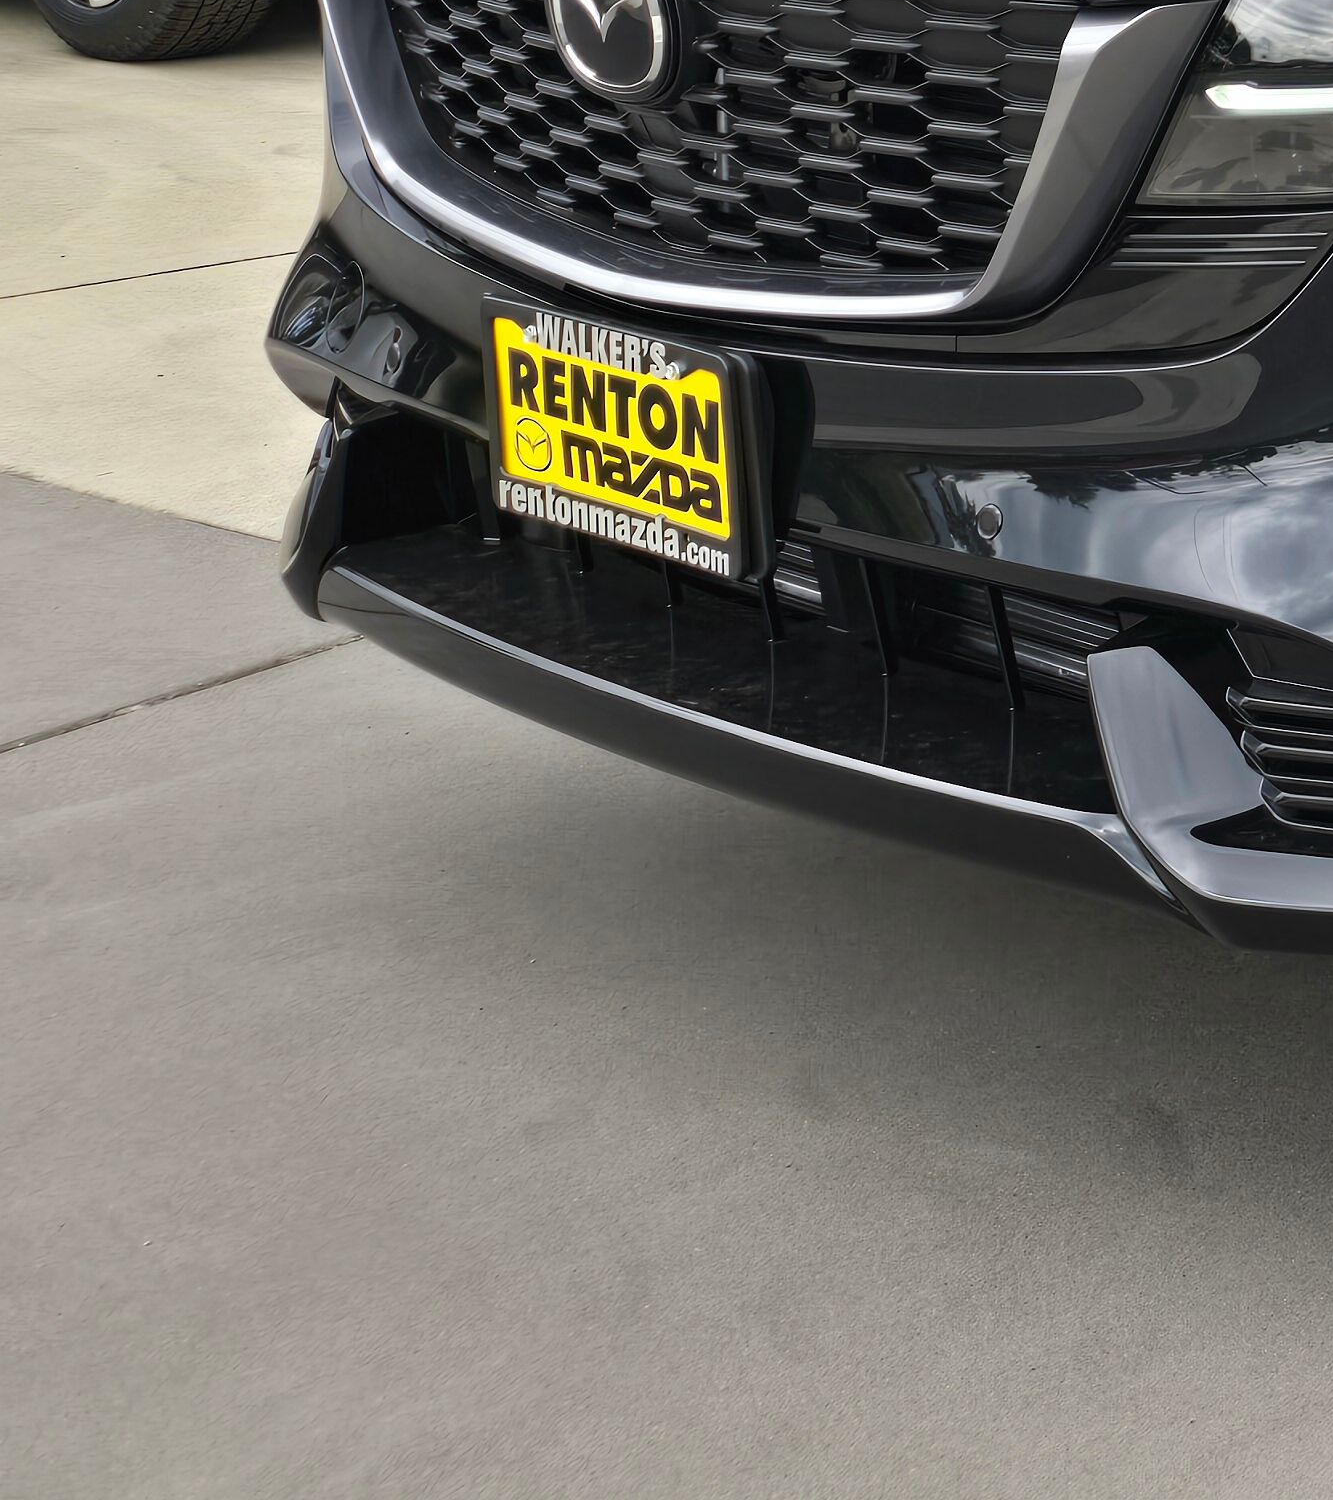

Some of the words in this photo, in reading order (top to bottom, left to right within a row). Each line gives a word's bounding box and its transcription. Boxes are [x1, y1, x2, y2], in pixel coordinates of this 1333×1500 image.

[536, 312, 666, 379] WALKER'S
[508, 346, 719, 464] RENTON
[561, 430, 722, 523] mazda
[499, 479, 730, 576] rentonmazda.com
